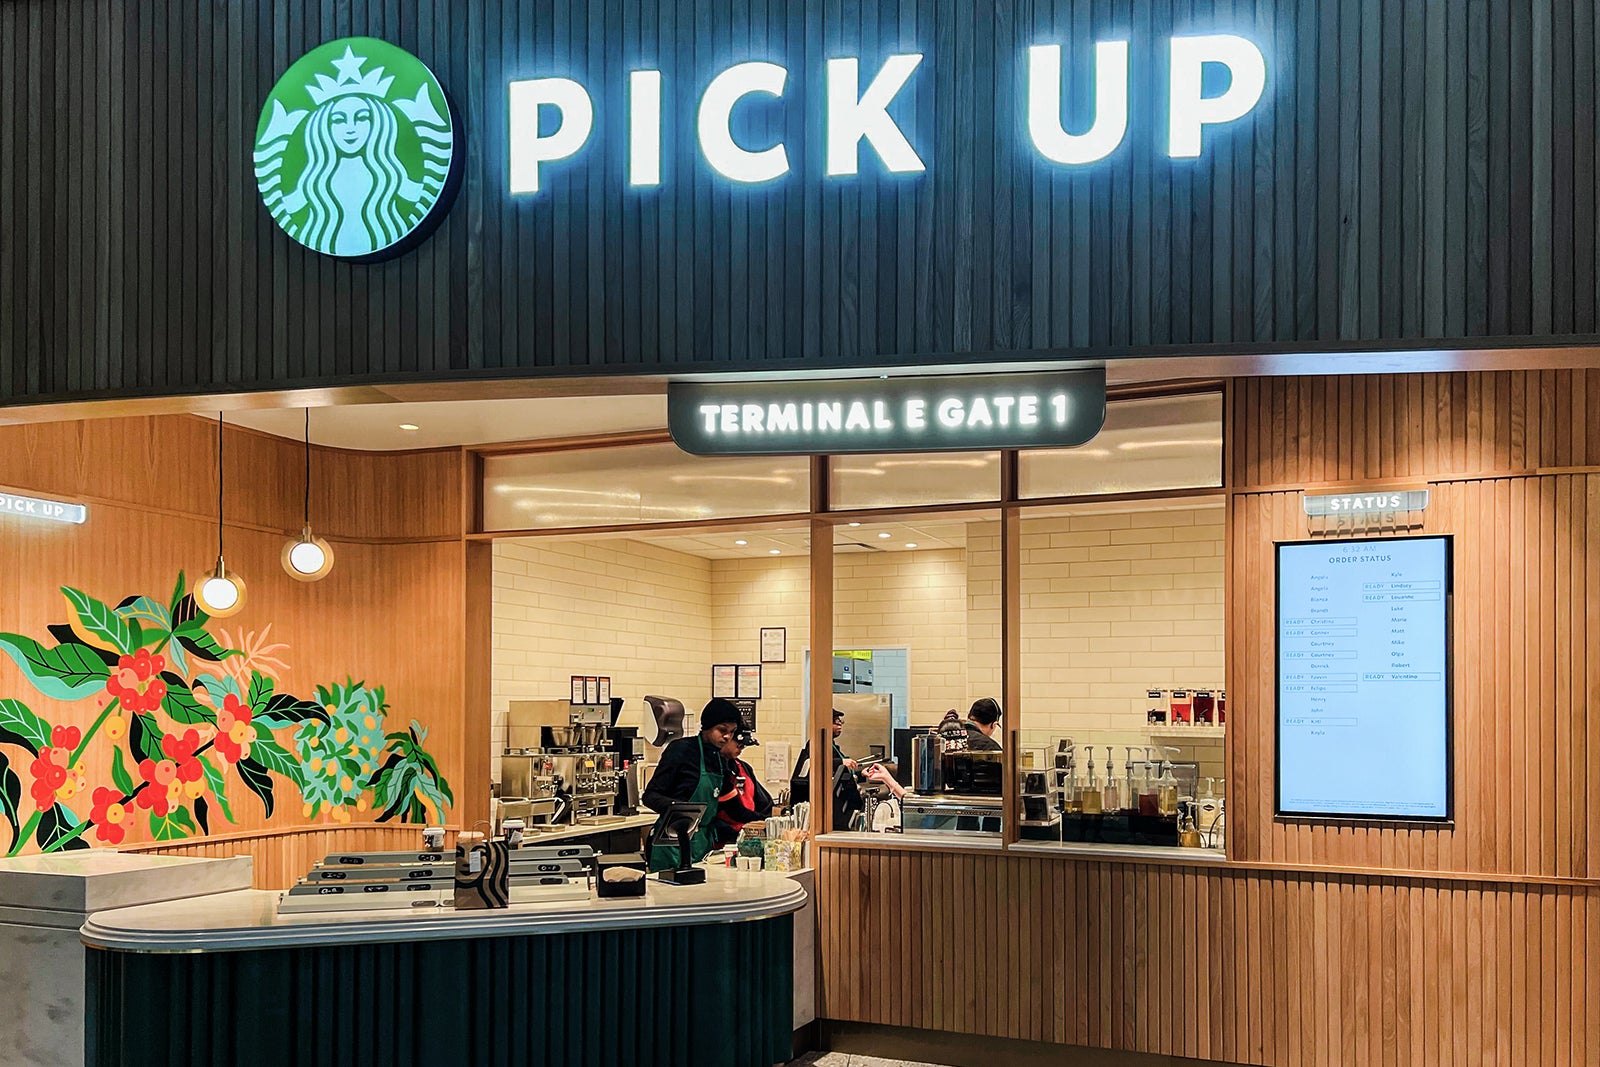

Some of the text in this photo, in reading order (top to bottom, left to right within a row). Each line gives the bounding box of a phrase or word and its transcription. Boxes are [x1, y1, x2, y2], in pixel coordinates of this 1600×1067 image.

[509, 34, 1267, 194] PICK UP
[700, 394, 1067, 432] TERMINAL E GATE 1
[43, 503, 64, 517] UP
[1330, 495, 1401, 510] STATUS
[1328, 556, 1358, 564] ORDER
